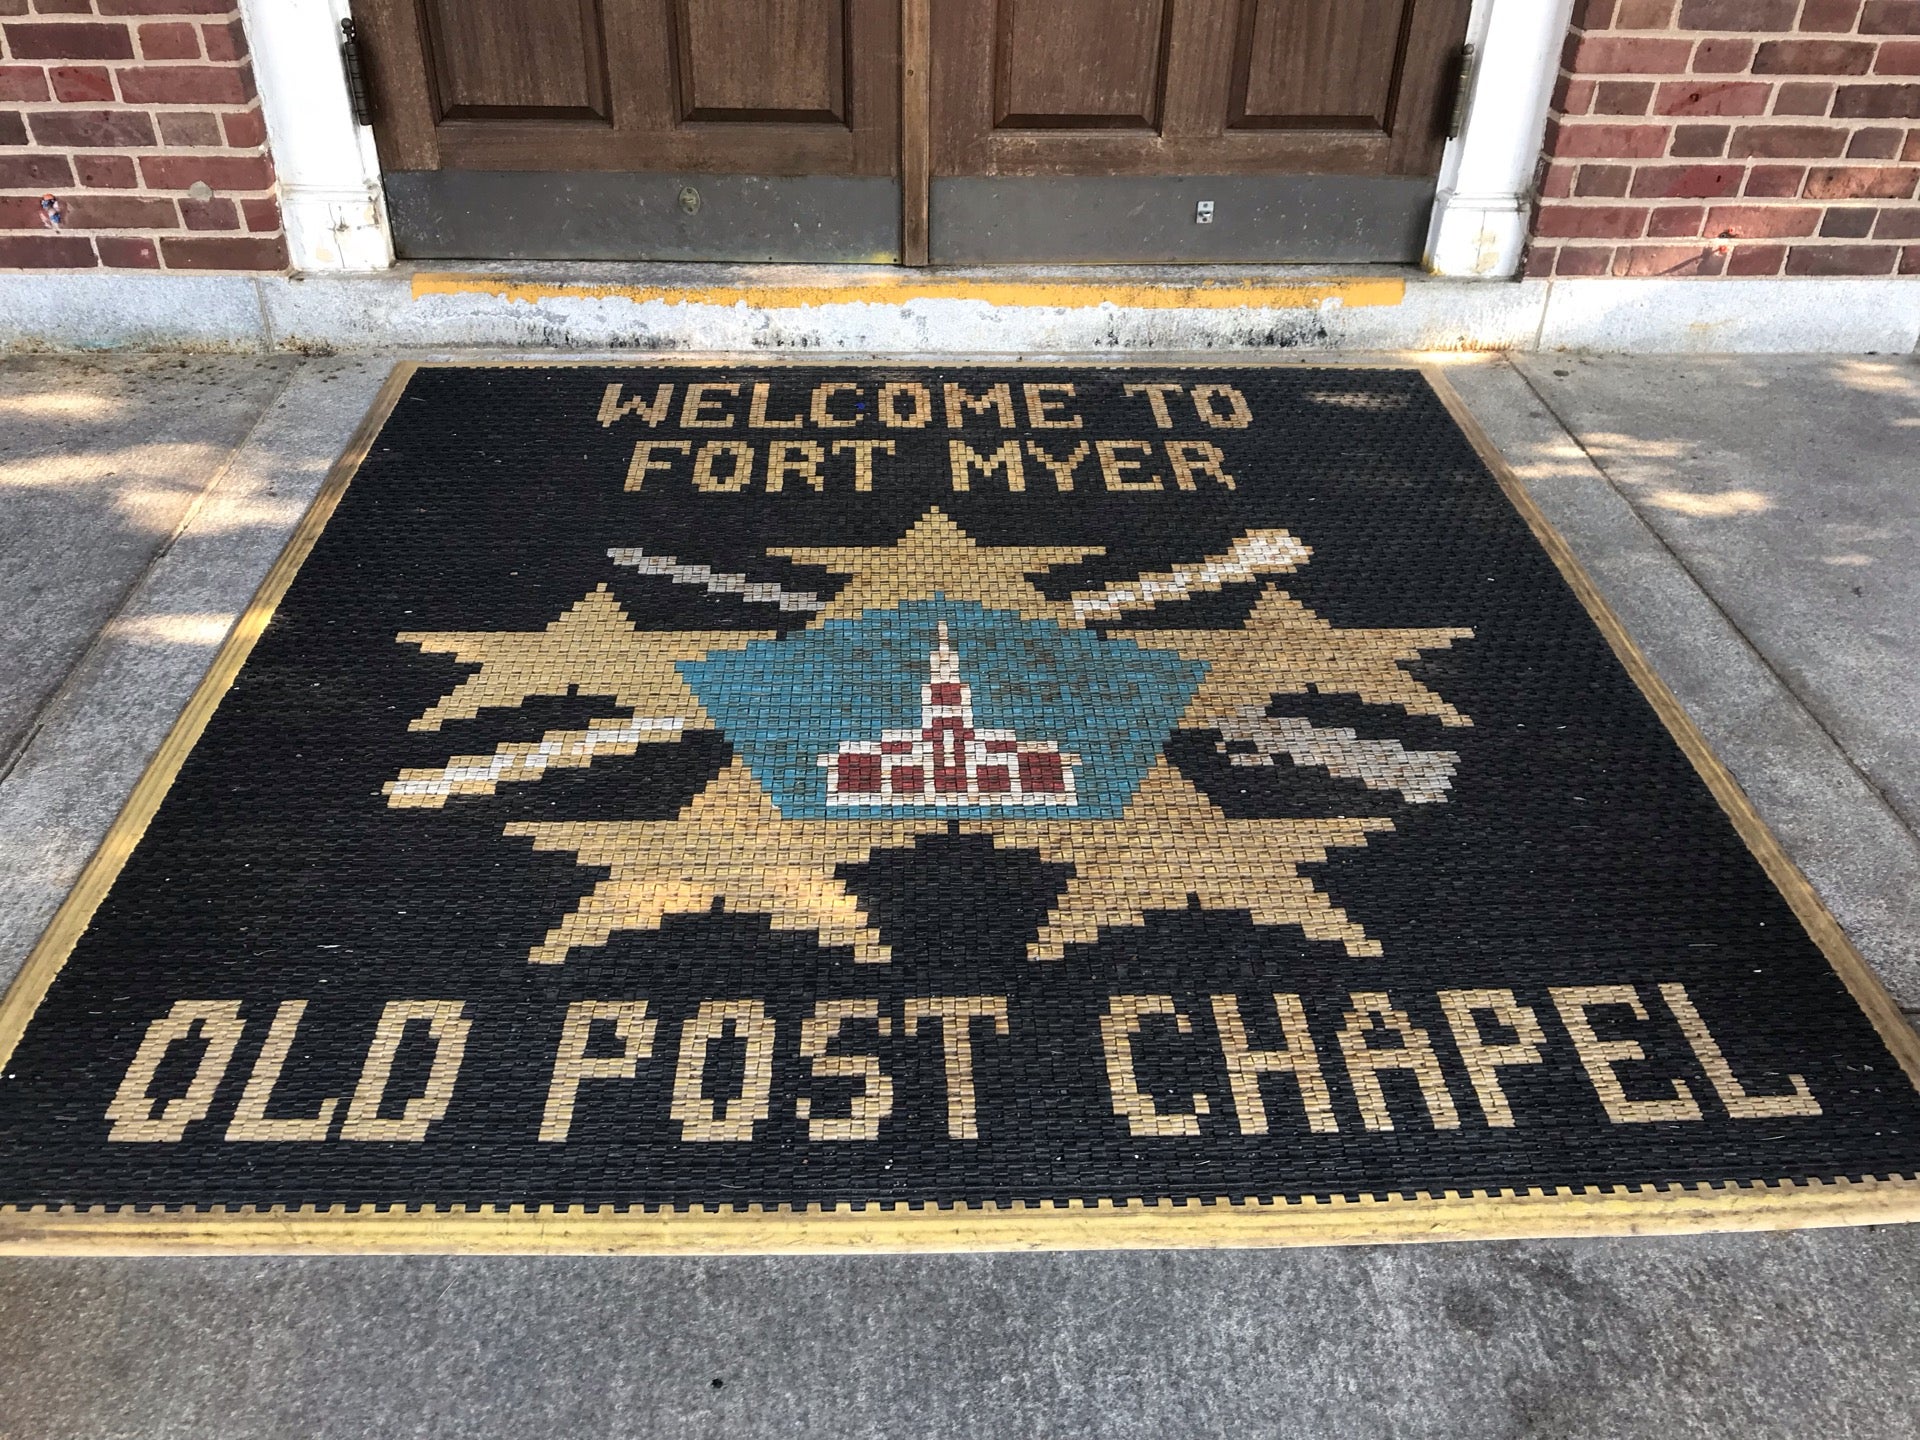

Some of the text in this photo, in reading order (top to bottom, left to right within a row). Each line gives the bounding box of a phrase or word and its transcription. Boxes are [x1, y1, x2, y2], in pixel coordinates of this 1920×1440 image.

[597, 382, 1254, 429] WELCOME TO
[622, 439, 1236, 493] FORT MYER
[105, 982, 1823, 1143] OLD POST CHAPEL
